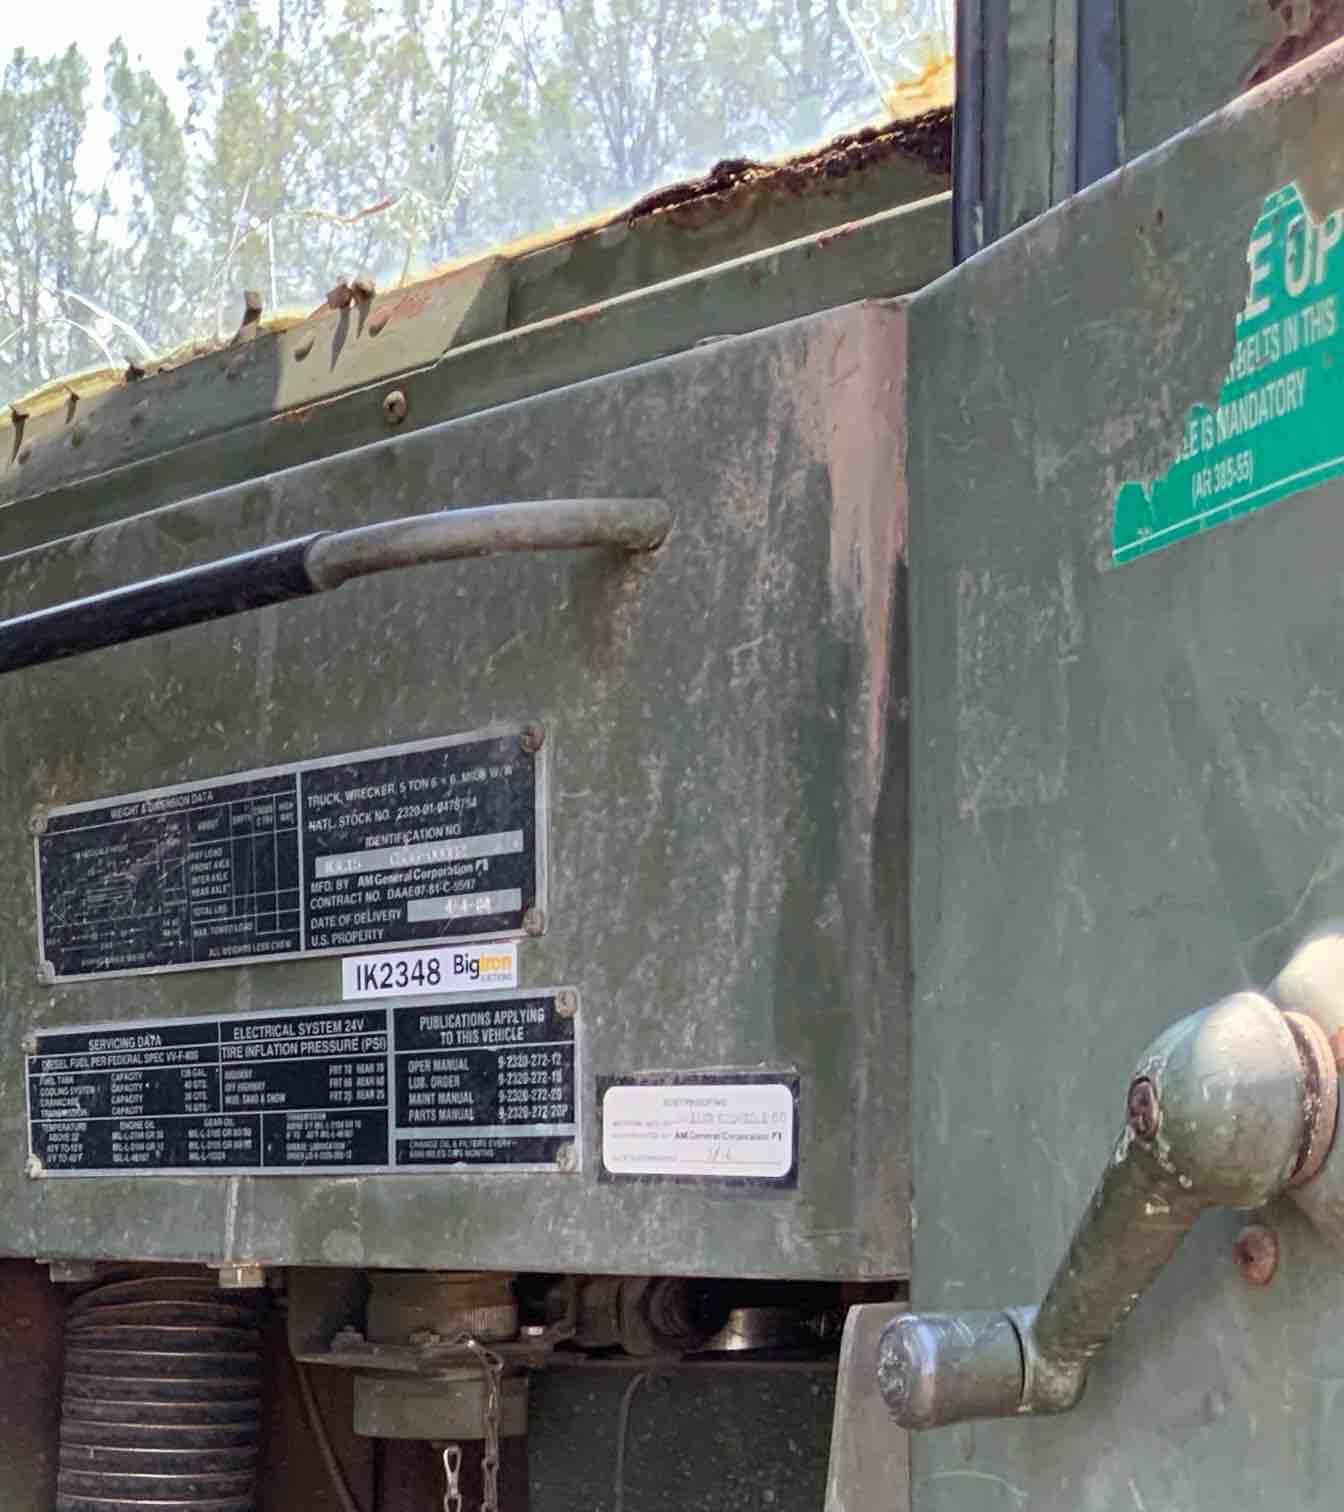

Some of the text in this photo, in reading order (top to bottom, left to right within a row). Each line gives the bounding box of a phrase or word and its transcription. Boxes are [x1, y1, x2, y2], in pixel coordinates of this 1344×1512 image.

[1284, 312, 1300, 354] IN
[1303, 296, 1338, 346] THIS
[1215, 367, 1308, 443] MANDATORY
[409, 778, 431, 792] TON
[339, 811, 372, 828] STOCK
[364, 826, 444, 848] IDENTIFICATION
[357, 875, 374, 888] AM
[374, 869, 412, 886] General
[413, 862, 474, 884] Corporation
[310, 891, 363, 910] CONTRACT
[311, 907, 403, 930] DATE OF DELIVERY
[311, 928, 385, 947] U.S. PROPERTY
[356, 957, 441, 991] IK2348
[233, 1018, 365, 1041] ELECTRICAL SYSTEM 24V
[419, 1008, 545, 1031] PUBLICATIONS APPLYING
[88, 1033, 162, 1052] SERVICING DATA
[440, 1026, 524, 1046] TO THIS VEHICLE
[222, 1037, 387, 1060] TIRE INFLATION PRESSURE (PSI)
[433, 1057, 470, 1072] MANUAL
[430, 1074, 460, 1088] ORDER
[438, 1091, 474, 1105] MANUAL
[408, 1107, 475, 1122] PARTS MANUAL
